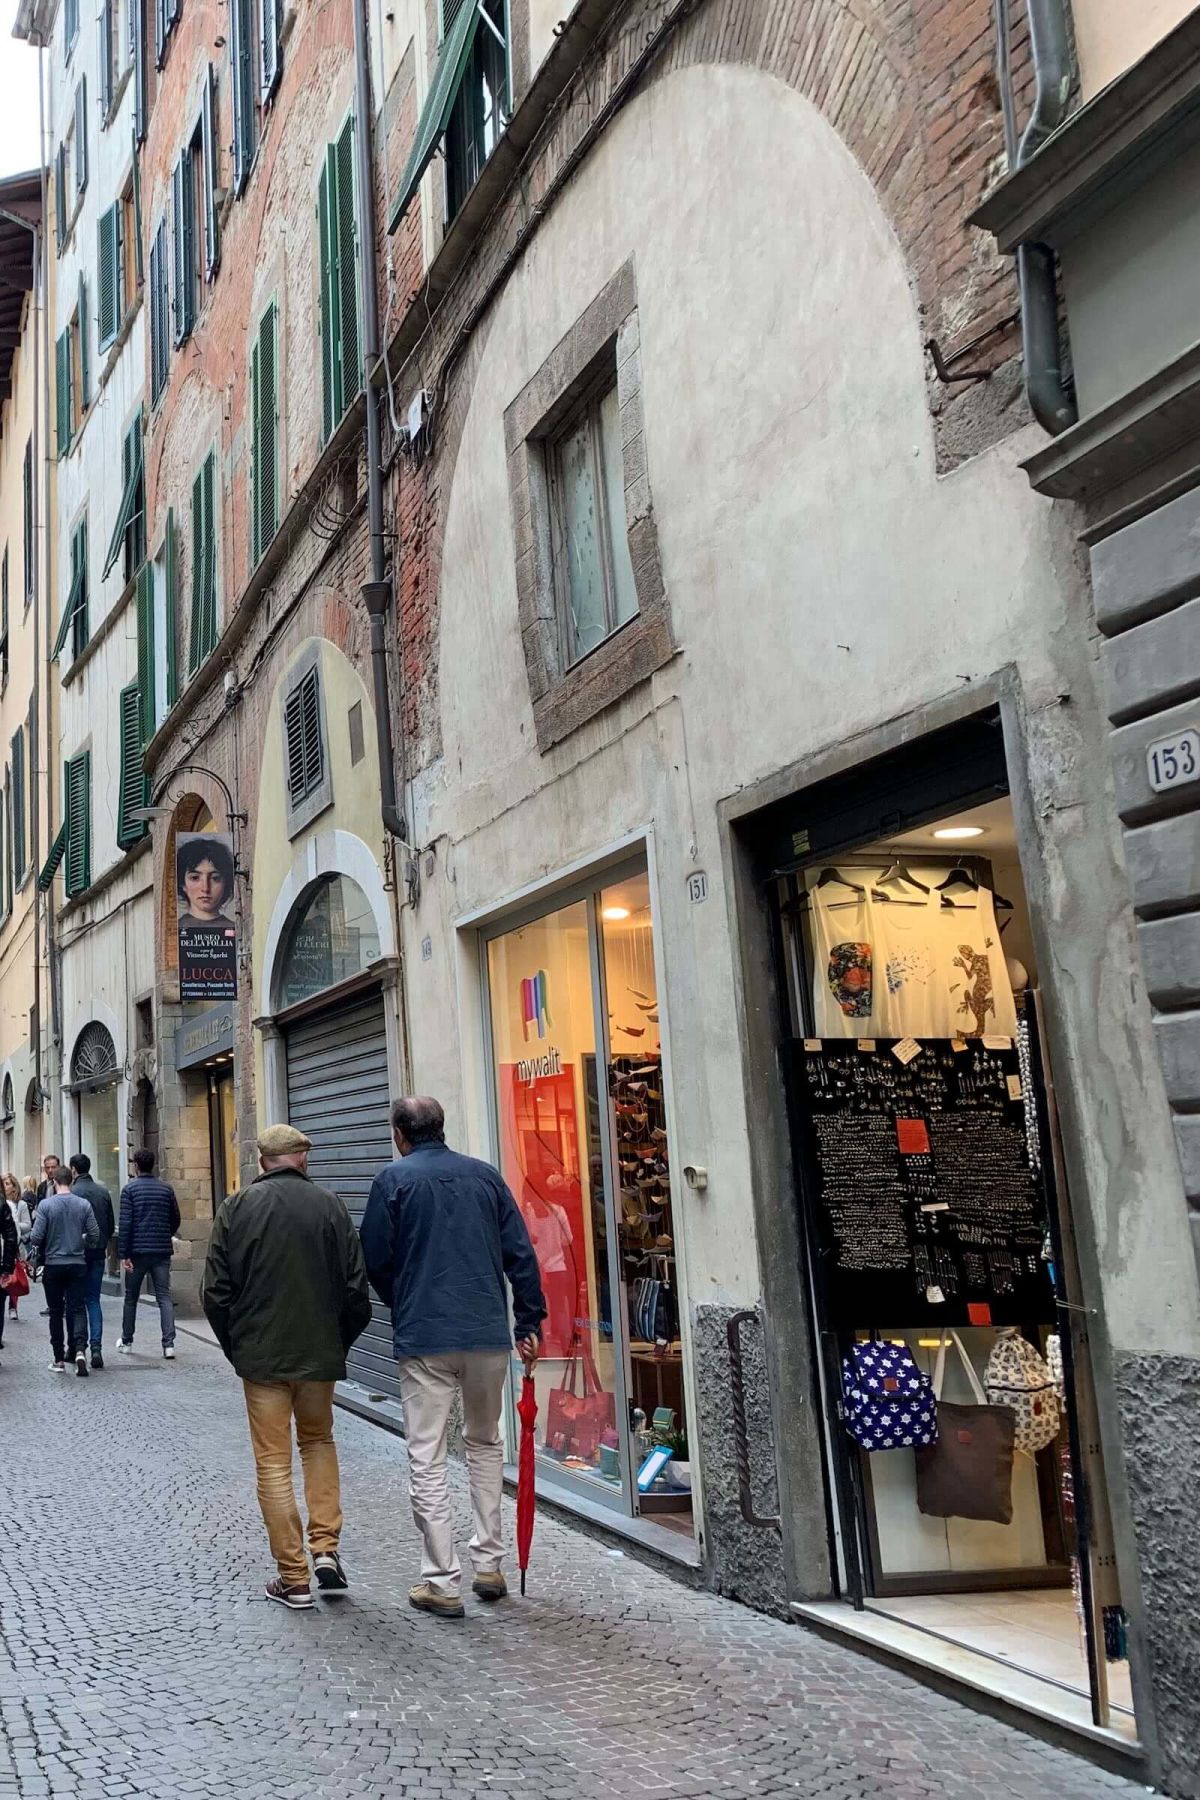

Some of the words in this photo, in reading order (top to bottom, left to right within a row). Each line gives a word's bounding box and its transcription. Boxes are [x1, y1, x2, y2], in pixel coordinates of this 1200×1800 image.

[1152, 740, 1195, 784] 153
[690, 875, 706, 901] 151
[206, 939, 233, 947] FOLLIA
[182, 967, 234, 980] LUCCA
[516, 1046, 560, 1087] mywalit
